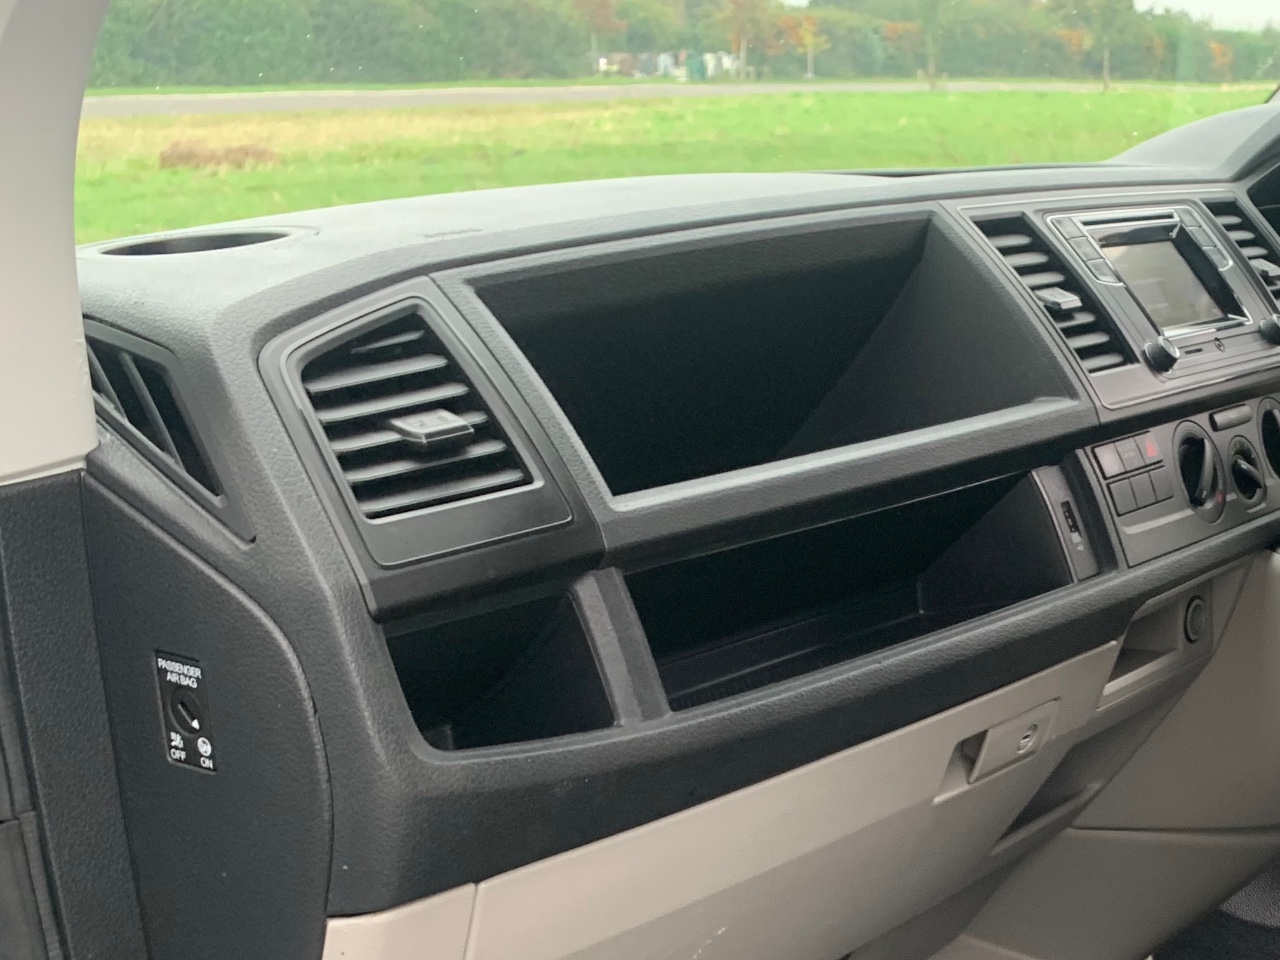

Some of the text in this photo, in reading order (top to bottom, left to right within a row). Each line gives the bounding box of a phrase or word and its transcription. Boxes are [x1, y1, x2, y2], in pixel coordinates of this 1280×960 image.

[157, 657, 202, 680] PASSENGER
[170, 748, 186, 761] OFF
[200, 756, 214, 769] ON
